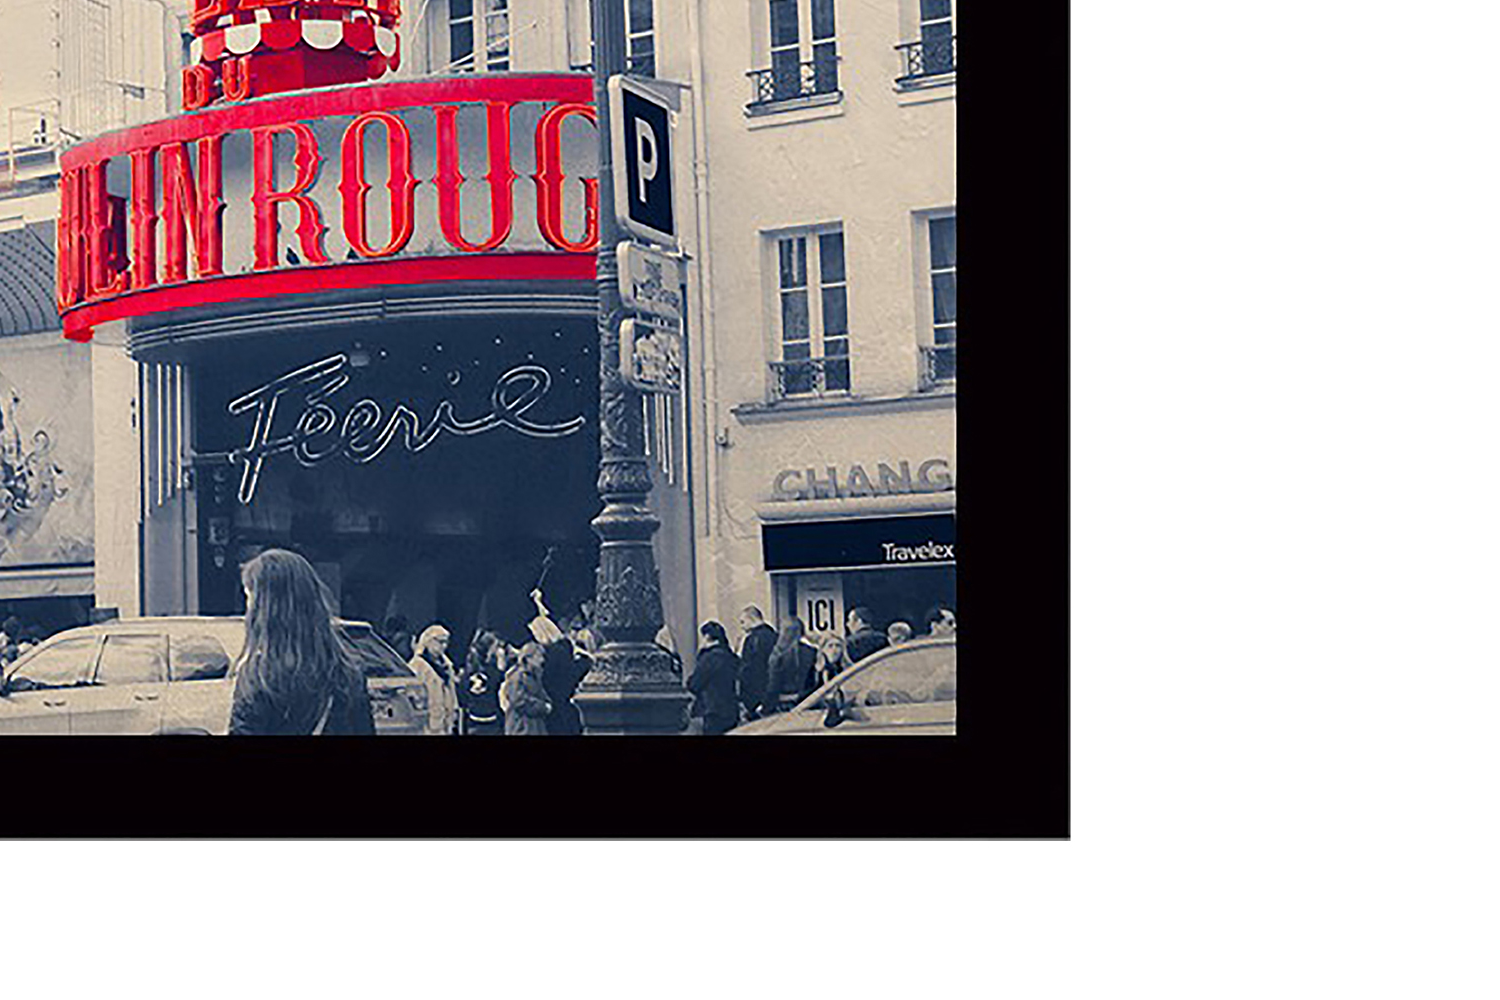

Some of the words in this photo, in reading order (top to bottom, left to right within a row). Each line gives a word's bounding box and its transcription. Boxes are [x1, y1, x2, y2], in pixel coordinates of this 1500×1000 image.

[182, 58, 250, 110] DU
[635, 116, 658, 203] P
[881, 541, 954, 561] Travelex
[807, 599, 835, 632] ICI
